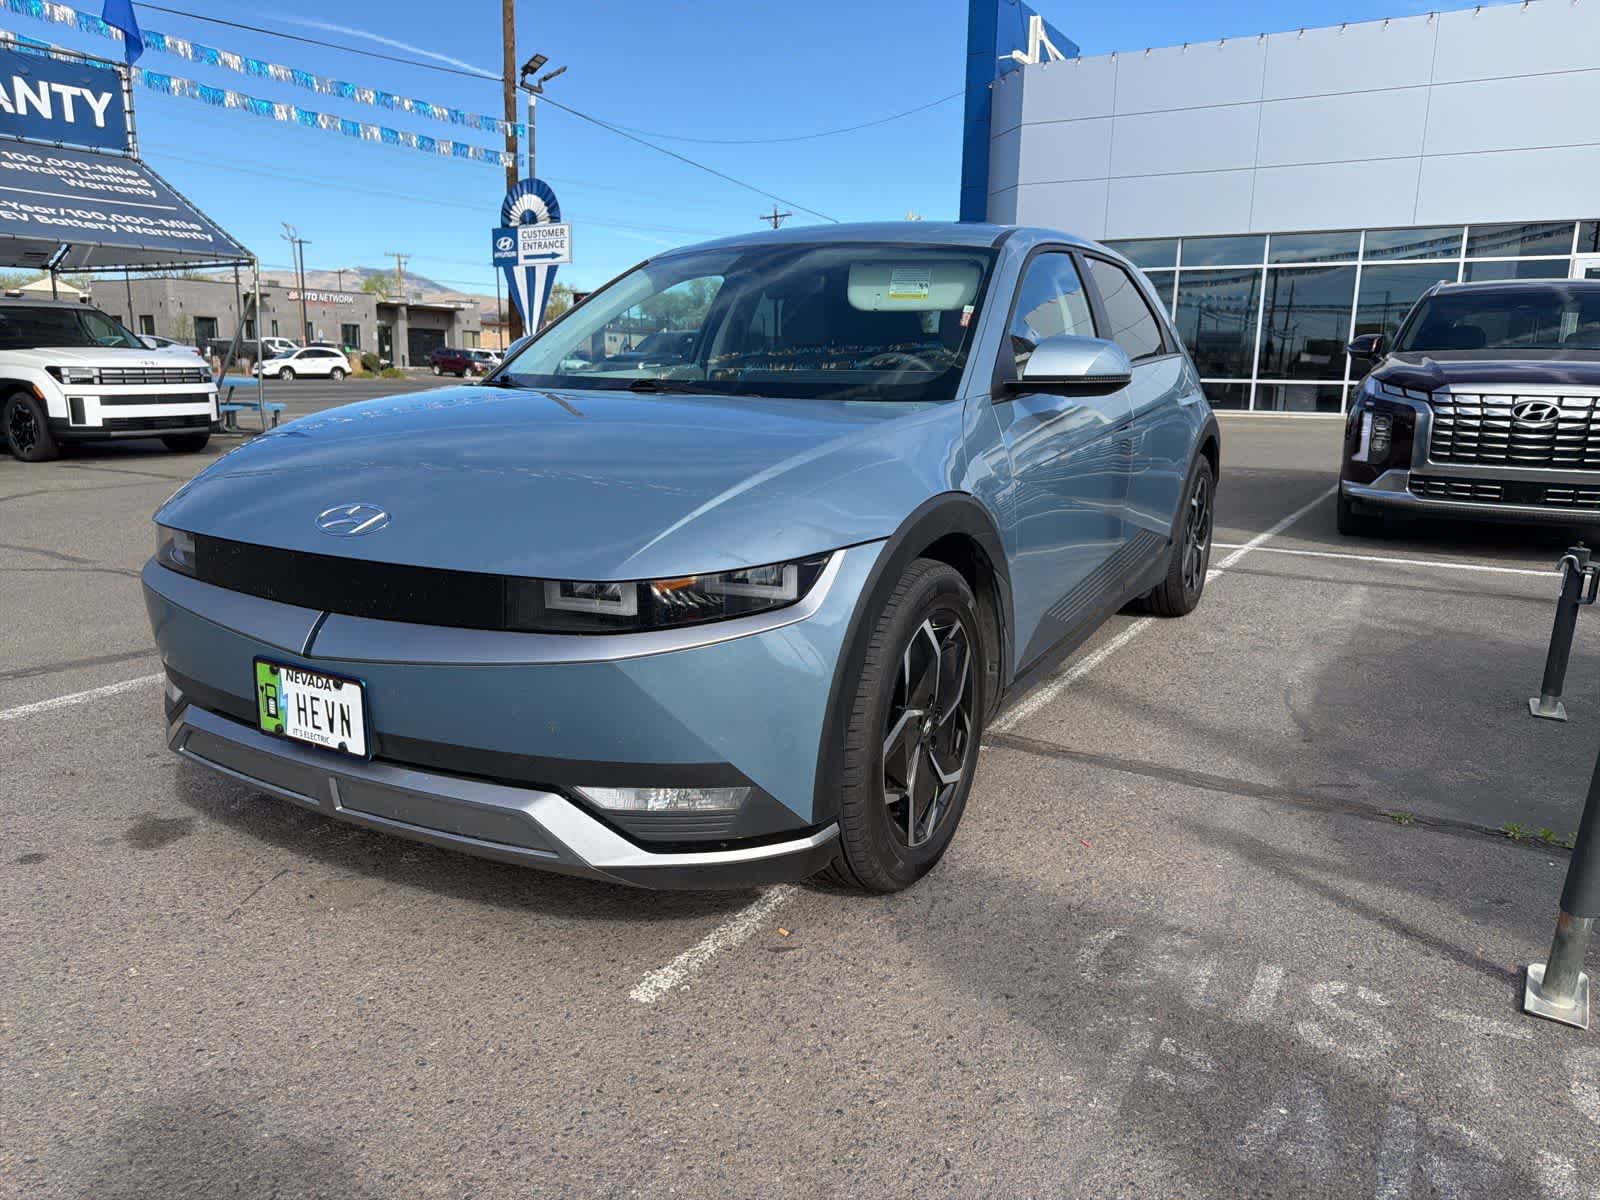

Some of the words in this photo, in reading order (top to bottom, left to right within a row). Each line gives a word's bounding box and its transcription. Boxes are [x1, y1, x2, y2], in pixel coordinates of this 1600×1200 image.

[60, 177, 157, 198] Warranty
[75, 170, 152, 188] Limited
[33, 214, 117, 233] Battery
[116, 224, 213, 243] Warranty
[521, 228, 565, 239] CUSTOMER
[522, 240, 565, 250] ENTRANCE
[319, 293, 354, 304] NETWORK
[285, 669, 332, 691] NEVADA
[295, 692, 352, 739] HEVN
[303, 731, 331, 745] ELECTRIC
